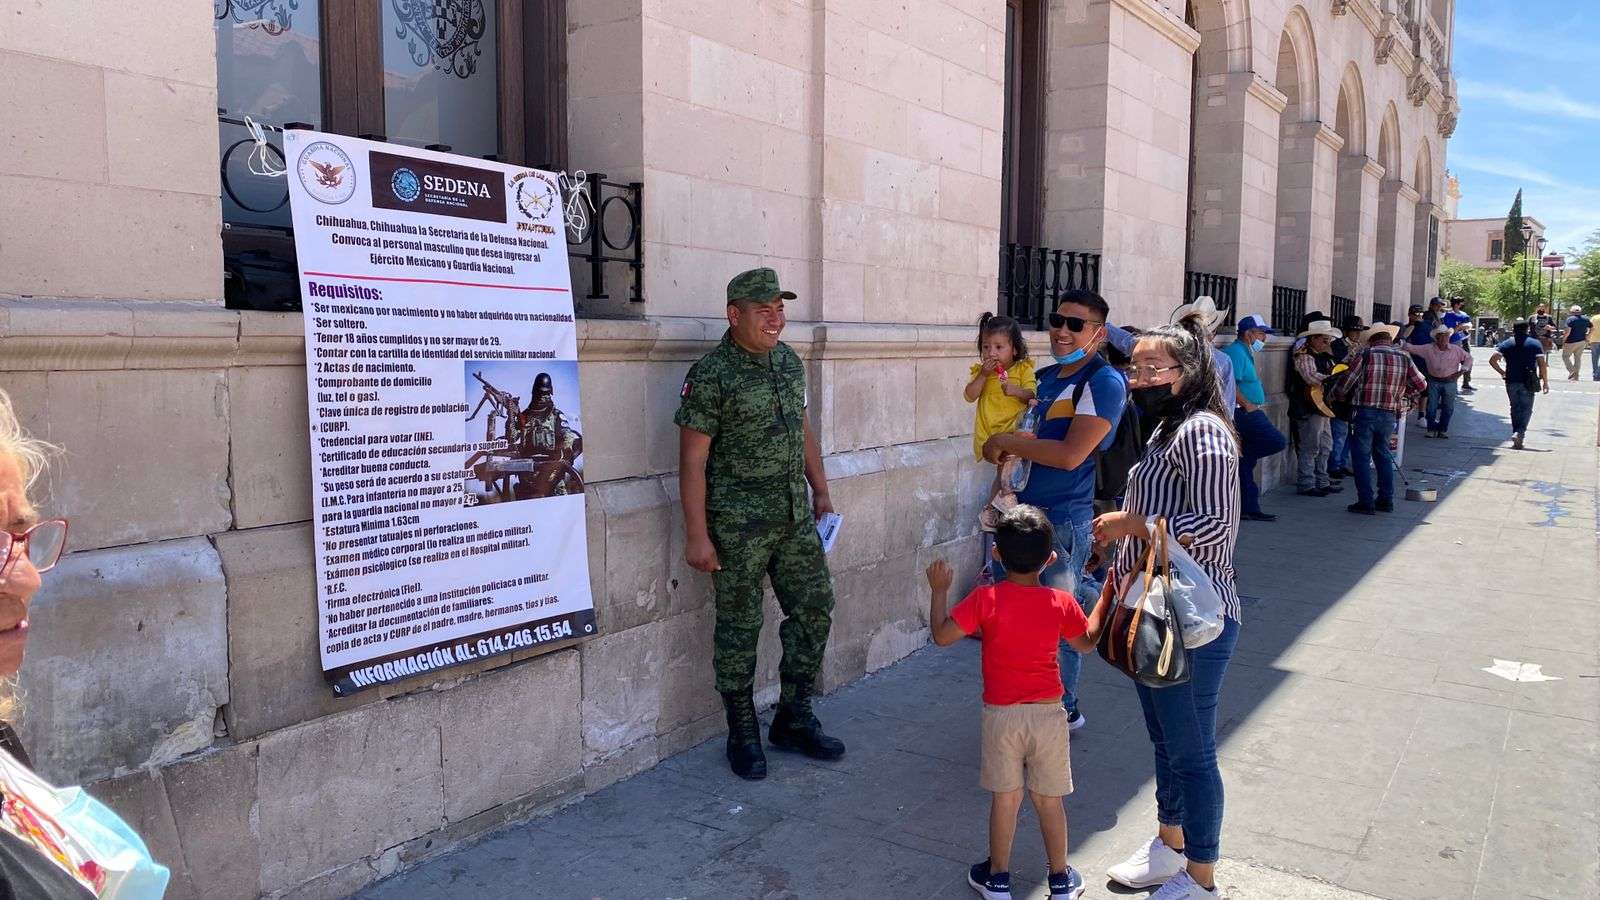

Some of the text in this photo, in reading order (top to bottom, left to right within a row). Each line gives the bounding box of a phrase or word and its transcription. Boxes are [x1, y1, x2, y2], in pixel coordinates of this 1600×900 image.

[424, 175, 491, 198] SEDENA
[370, 220, 417, 234] Chihuahua
[469, 231, 479, 241] de
[488, 233, 517, 245] Defensa
[331, 232, 541, 262] Convoca al personal masculino que desea ingresar al
[406, 255, 446, 268] Mexicano
[452, 259, 481, 271] Guardia
[308, 281, 382, 300] Requisitos:
[331, 304, 374, 315] mexicano
[375, 307, 390, 316] por
[391, 307, 438, 317] nacimiento
[445, 309, 456, 318] no
[456, 309, 477, 319] haber
[478, 311, 513, 320] adquirido
[513, 312, 528, 321] otra
[344, 332, 354, 343] 18
[379, 334, 422, 344] cumplidos
[429, 336, 440, 345] no
[441, 336, 454, 345] ser
[455, 337, 478, 346] mayor
[479, 336, 489, 346] de
[349, 349, 366, 358] con
[378, 348, 408, 358] cartilla
[409, 348, 420, 358] de
[421, 348, 458, 358] identidad
[459, 348, 472, 358] del
[473, 349, 503, 358] servicio
[503, 349, 527, 358] militar
[323, 362, 350, 372] Actas
[351, 362, 363, 372] de
[380, 376, 391, 387] de
[393, 376, 432, 386] domicilio
[335, 391, 347, 402] tel
[370, 405, 382, 415] de
[384, 405, 418, 416] registro
[419, 404, 430, 414] de
[367, 435, 388, 445] para
[389, 433, 412, 443] votar
[368, 448, 380, 458] de
[427, 442, 471, 454] secundaria
[360, 463, 387, 473] buena
[334, 480, 354, 492] peso
[375, 476, 386, 486] de
[387, 473, 422, 485] acuerdo
[430, 472, 441, 481] su
[346, 494, 364, 504] Para
[407, 488, 418, 497] no
[419, 485, 445, 495] mayor
[321, 511, 342, 523] para
[352, 505, 382, 519] guardia
[383, 500, 419, 513] nacional
[420, 500, 430, 509] no
[432, 497, 456, 507] mayor
[338, 535, 377, 550] presentar
[378, 530, 412, 542] tatuajes
[339, 608, 365, 621] haber
[366, 598, 415, 616] pertenecido
[422, 594, 438, 604] una
[440, 603, 450, 614] de
[326, 640, 349, 654] copia
[350, 637, 362, 648] de
[362, 633, 381, 645] acta
[389, 626, 411, 639] CURP
[411, 624, 422, 634] de
[349, 620, 572, 687] INFORMACIÓN AL: 614.246.15.54
